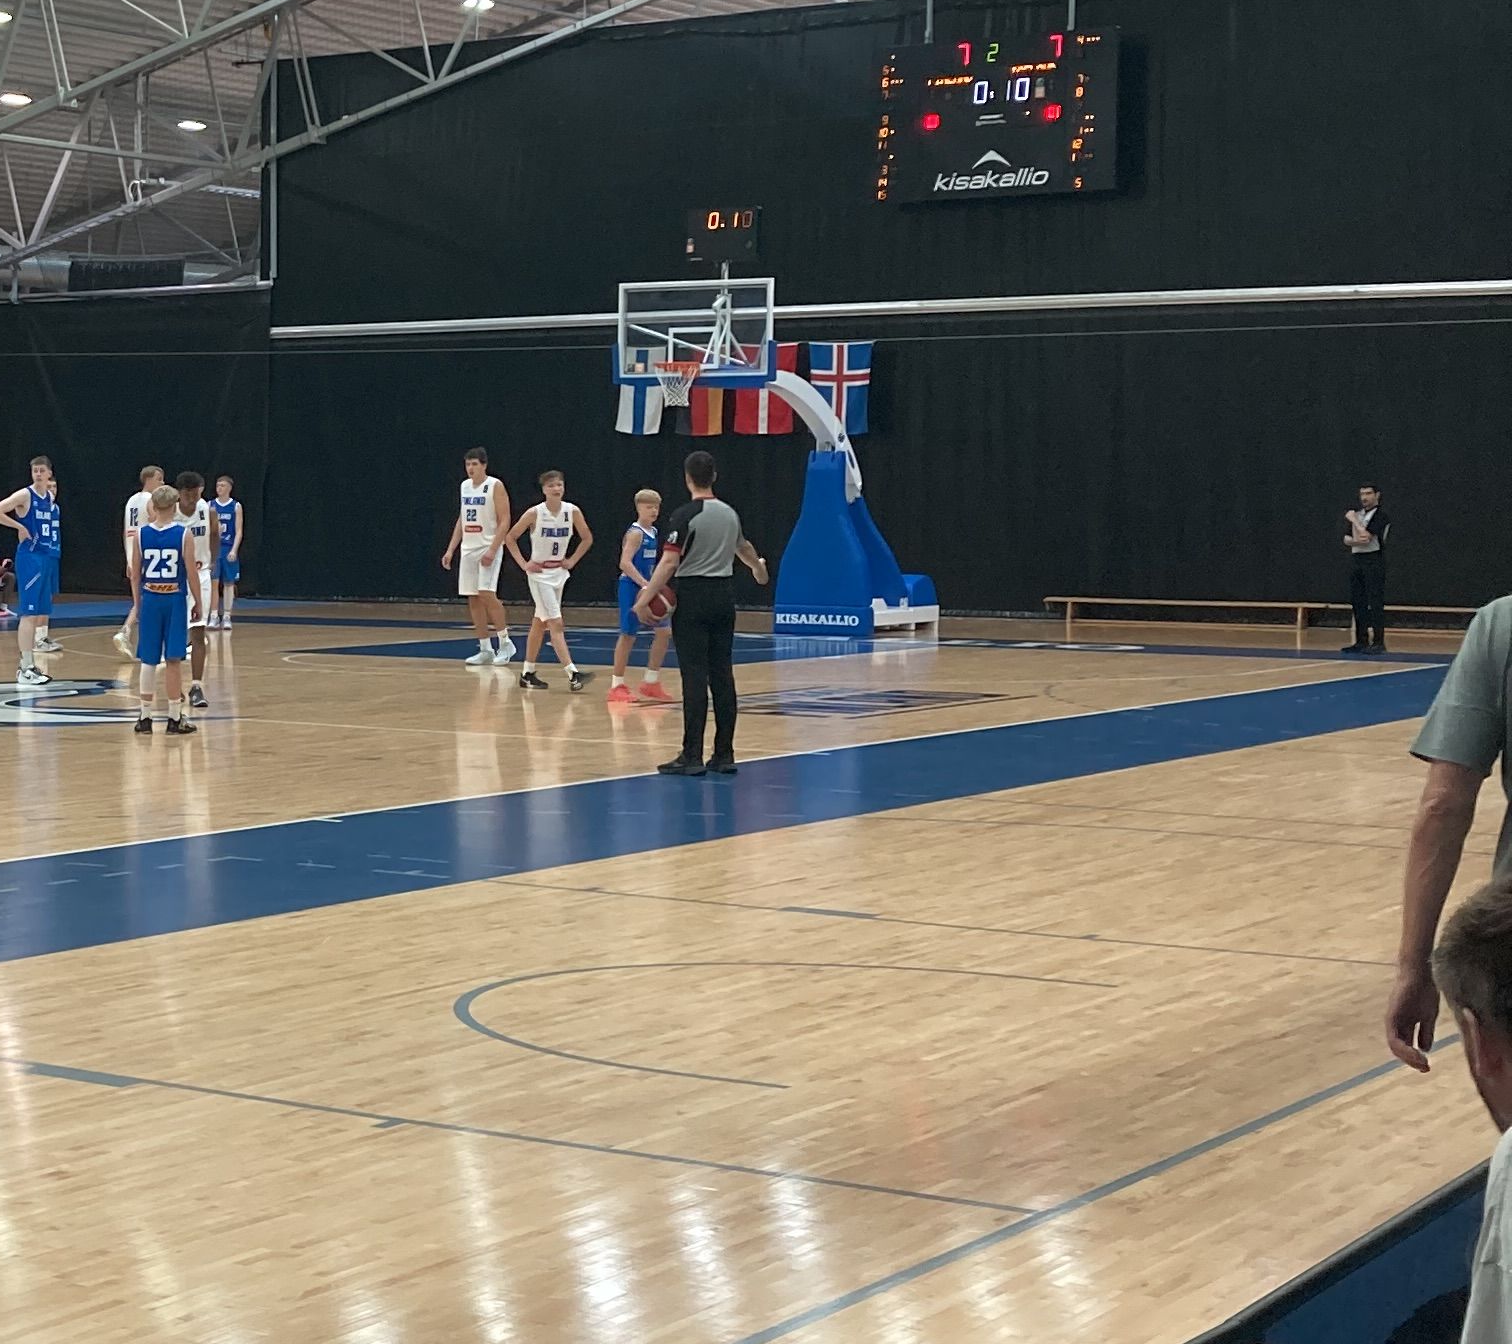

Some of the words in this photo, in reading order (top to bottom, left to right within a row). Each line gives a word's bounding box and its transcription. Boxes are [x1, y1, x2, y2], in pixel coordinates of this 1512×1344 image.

[958, 42, 972, 66] 7
[987, 43, 999, 62] 2
[1049, 34, 1064, 58] 7
[933, 167, 1050, 192] kisakallio
[143, 548, 179, 579] 23
[775, 613, 859, 626] KISAKALLIO
